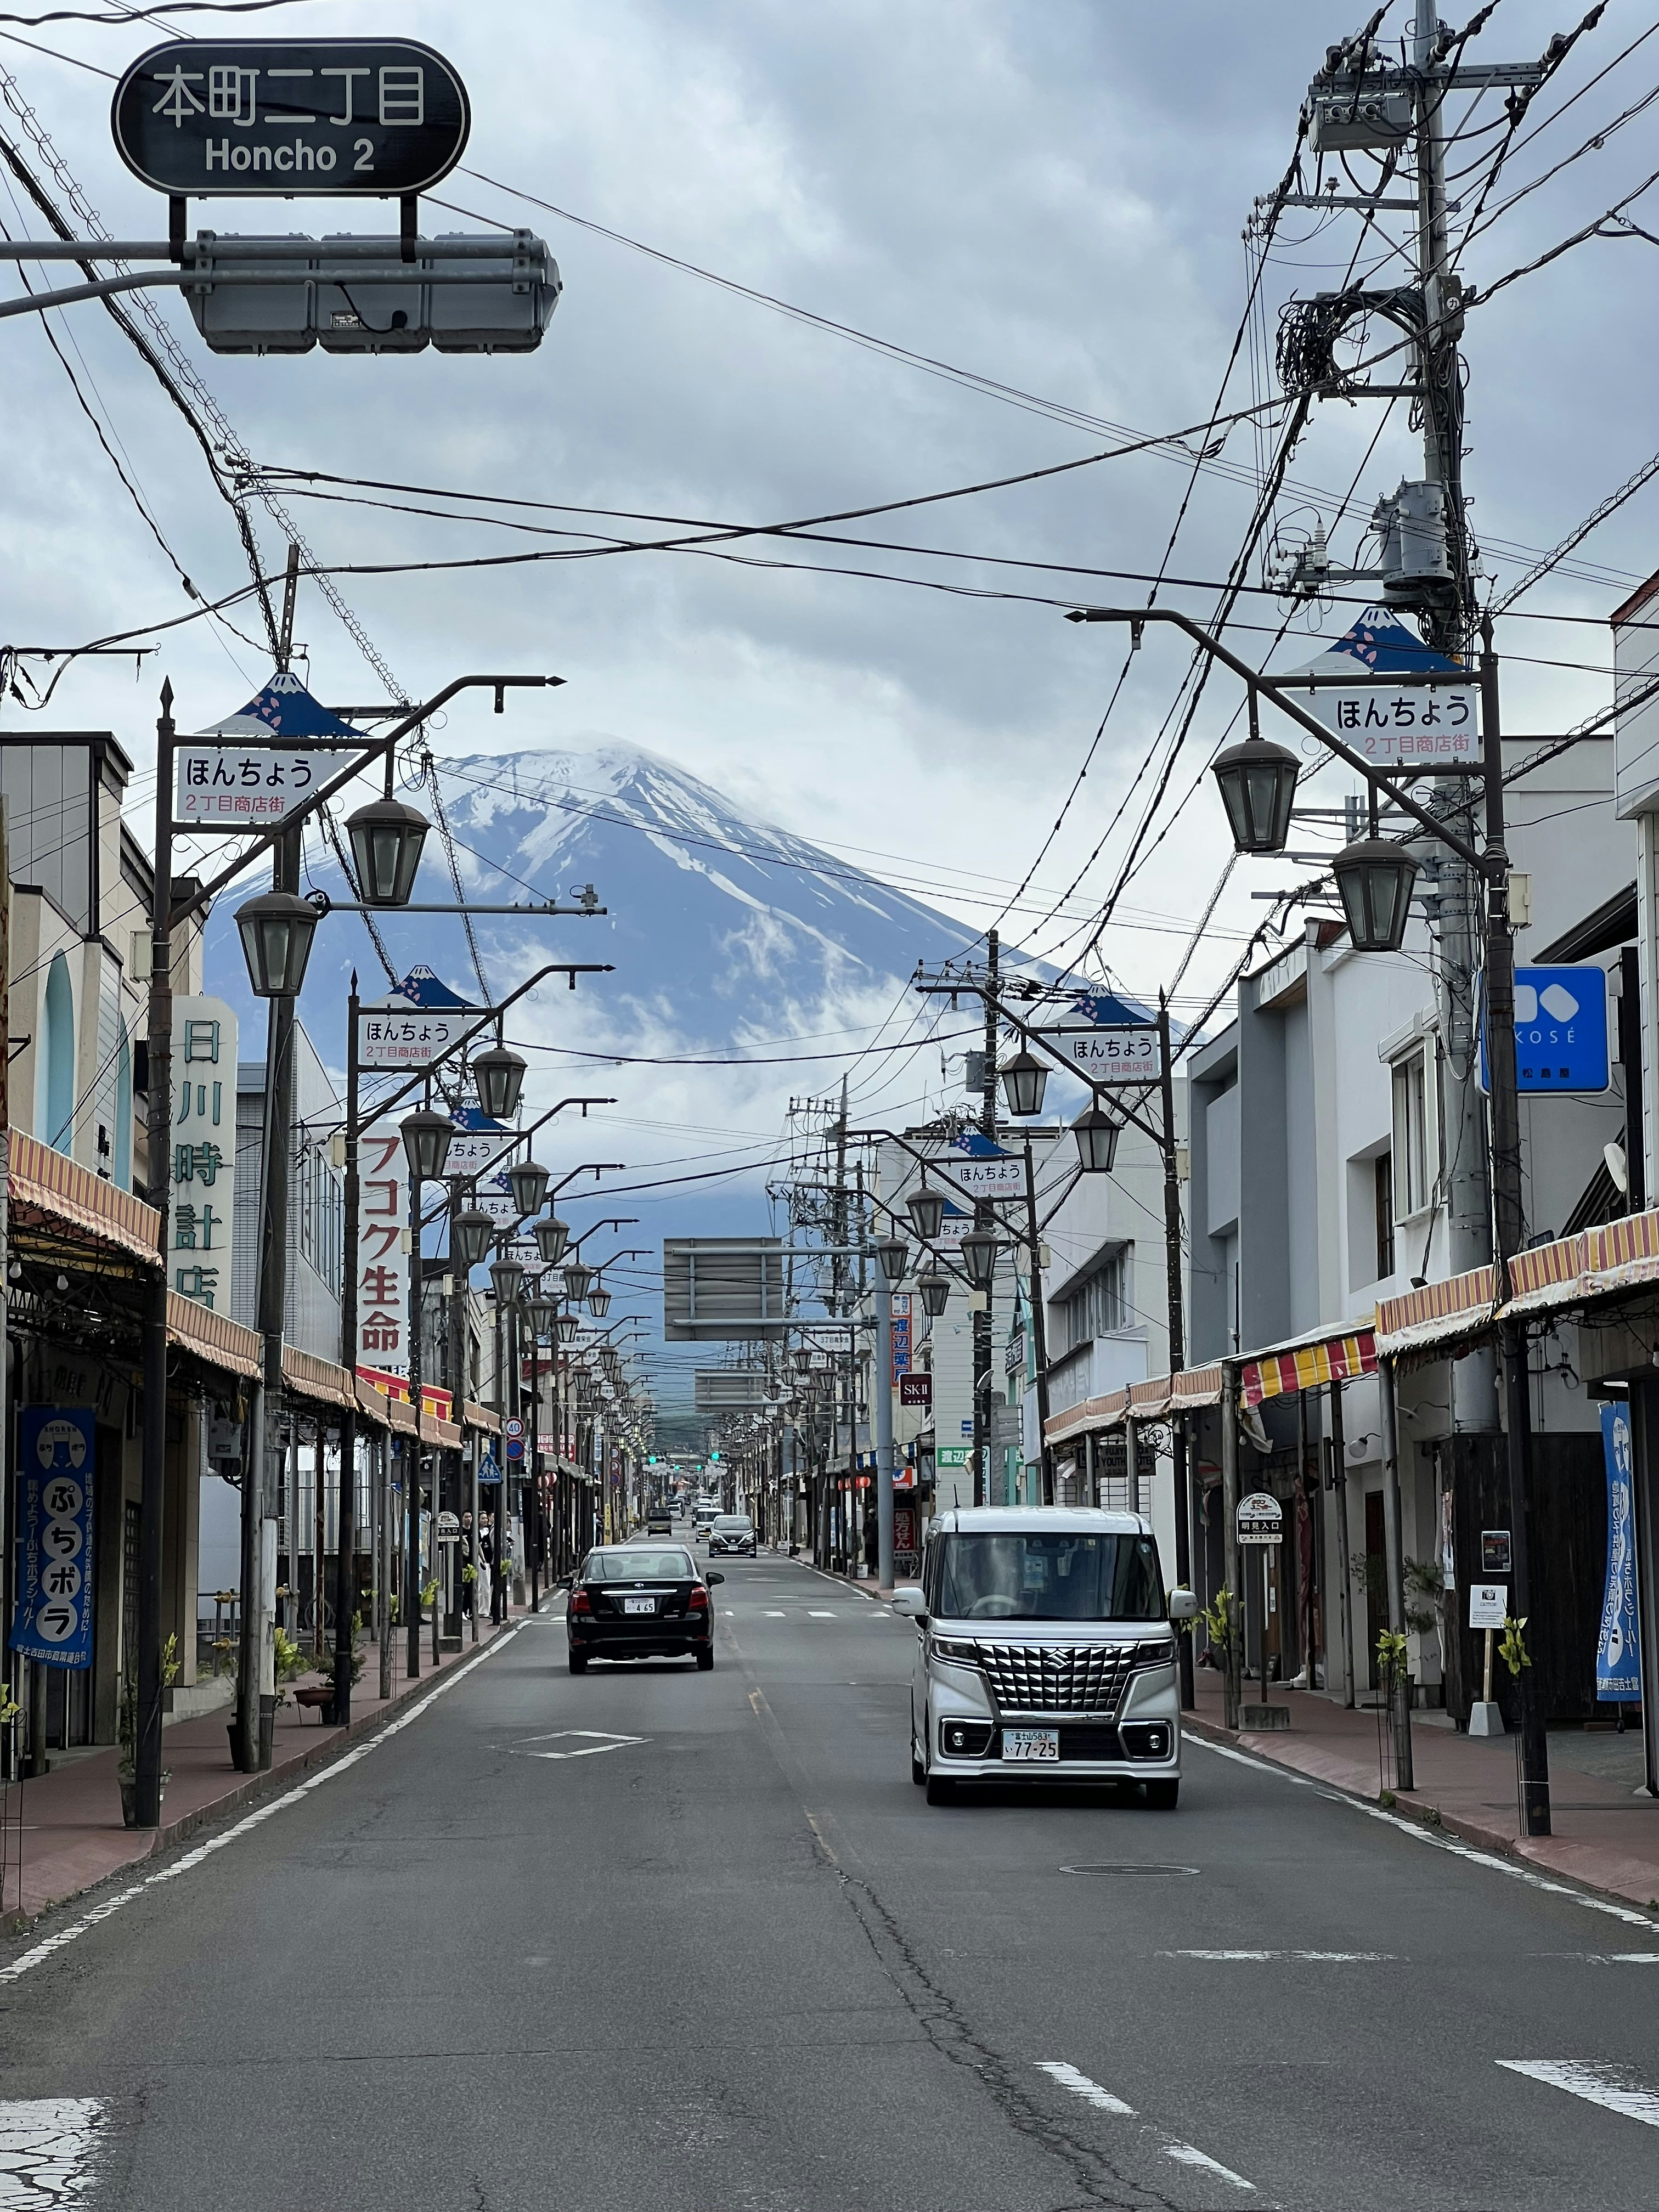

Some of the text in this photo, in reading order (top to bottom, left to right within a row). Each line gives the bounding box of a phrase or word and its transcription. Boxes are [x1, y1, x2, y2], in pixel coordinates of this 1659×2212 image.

[152, 65, 423, 128] 本町二丁目
[206, 138, 374, 171] Honcho 2
[1338, 695, 1470, 729] ほんちょう
[1365, 733, 1470, 754] 2丁目商店街
[187, 757, 312, 788] ほんちょう
[185, 794, 285, 813] 2丁目商店街
[366, 1022, 449, 1042] ほんちょう
[366, 1046, 432, 1058] 2丁目商店街
[1074, 1037, 1153, 1060] ほんちょう
[1091, 1061, 1153, 1074] 2丁目商店街
[447, 1142, 490, 1158] ちょう
[177, 1019, 223, 1308] 日川時計店
[960, 1165, 1020, 1182] ほんちょう
[973, 1182, 1020, 1193] 2丁目商店街
[941, 1223, 969, 1235] ちょう
[360, 1136, 402, 1351] フコク生命
[904, 1384, 928, 1395] SK-II
[509, 1423, 520, 1433] 40
[1102, 1456, 1126, 1467] YOUTH
[895, 1513, 910, 1549] 処方せん
[1242, 1522, 1279, 1530] 明見入口
[44, 1485, 76, 1636] ぷちボラ
[1014, 1742, 1056, 1757] 77-25
